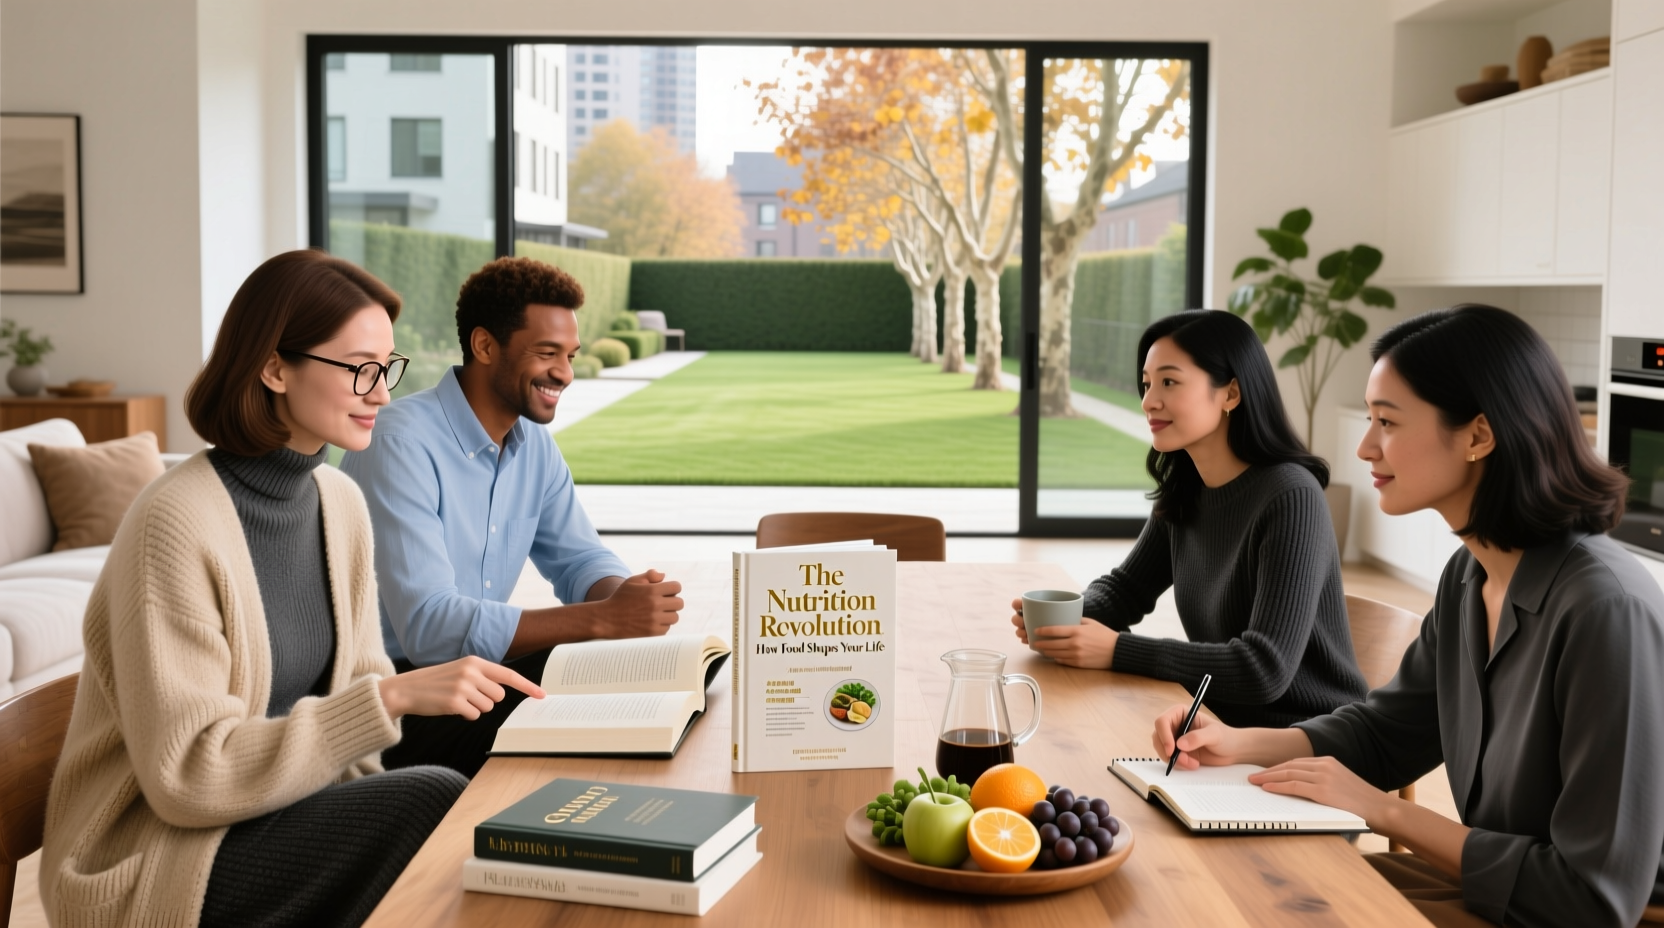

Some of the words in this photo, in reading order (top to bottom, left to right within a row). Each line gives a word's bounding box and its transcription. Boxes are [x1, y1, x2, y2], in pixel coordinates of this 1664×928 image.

[799, 563, 844, 586] The
[767, 589, 877, 613] Nutrition
[759, 614, 882, 638] Revolution
[756, 643, 778, 655] How
[865, 640, 885, 653] Life
